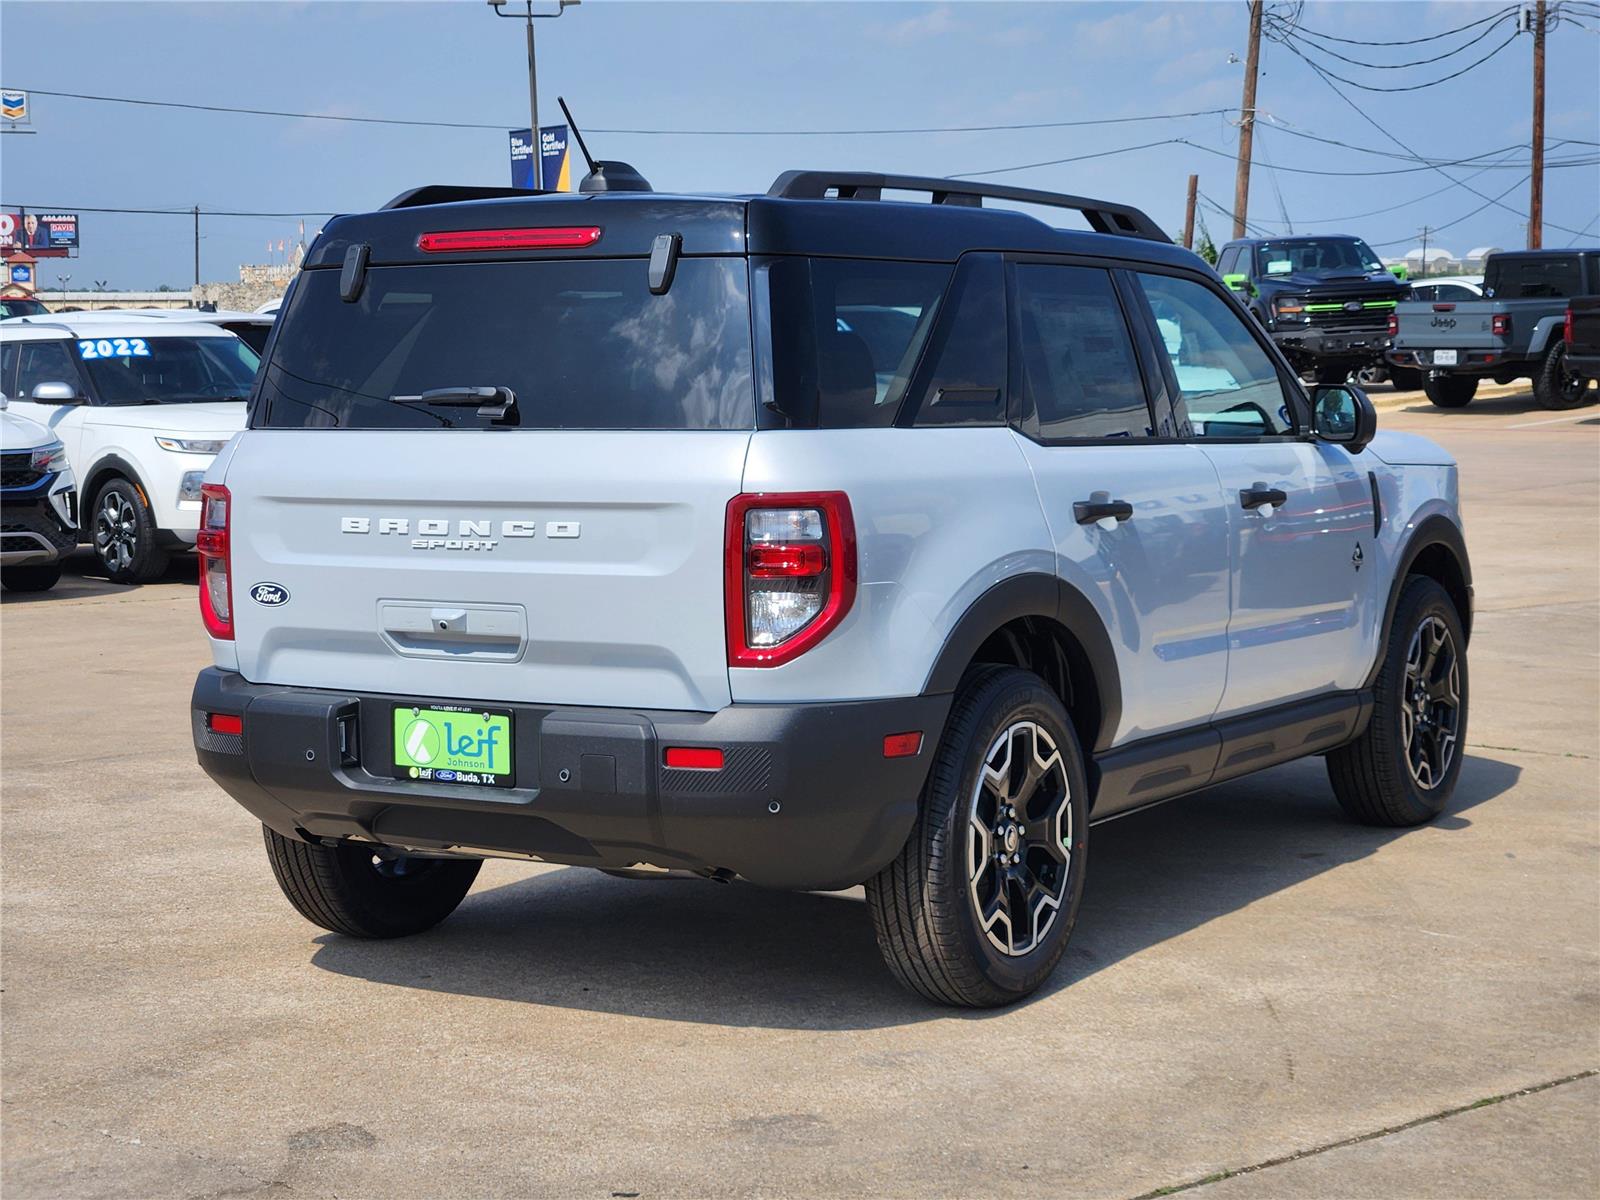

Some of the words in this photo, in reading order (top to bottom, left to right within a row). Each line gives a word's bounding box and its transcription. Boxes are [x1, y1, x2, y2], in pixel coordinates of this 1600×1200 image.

[511, 138, 523, 147] Blue
[542, 133, 555, 142] Gold
[511, 144, 533, 155] Certified
[543, 140, 565, 151] Certified
[1431, 316, 1457, 329] Jeep
[79, 339, 150, 359] 2022
[341, 517, 581, 538] BRONCO
[411, 539, 498, 550] SPORT
[256, 585, 281, 602] Ford
[444, 721, 501, 768] leif
[447, 758, 485, 768] Johnson
[456, 771, 480, 784] Buda,
[481, 774, 495, 784] TX
